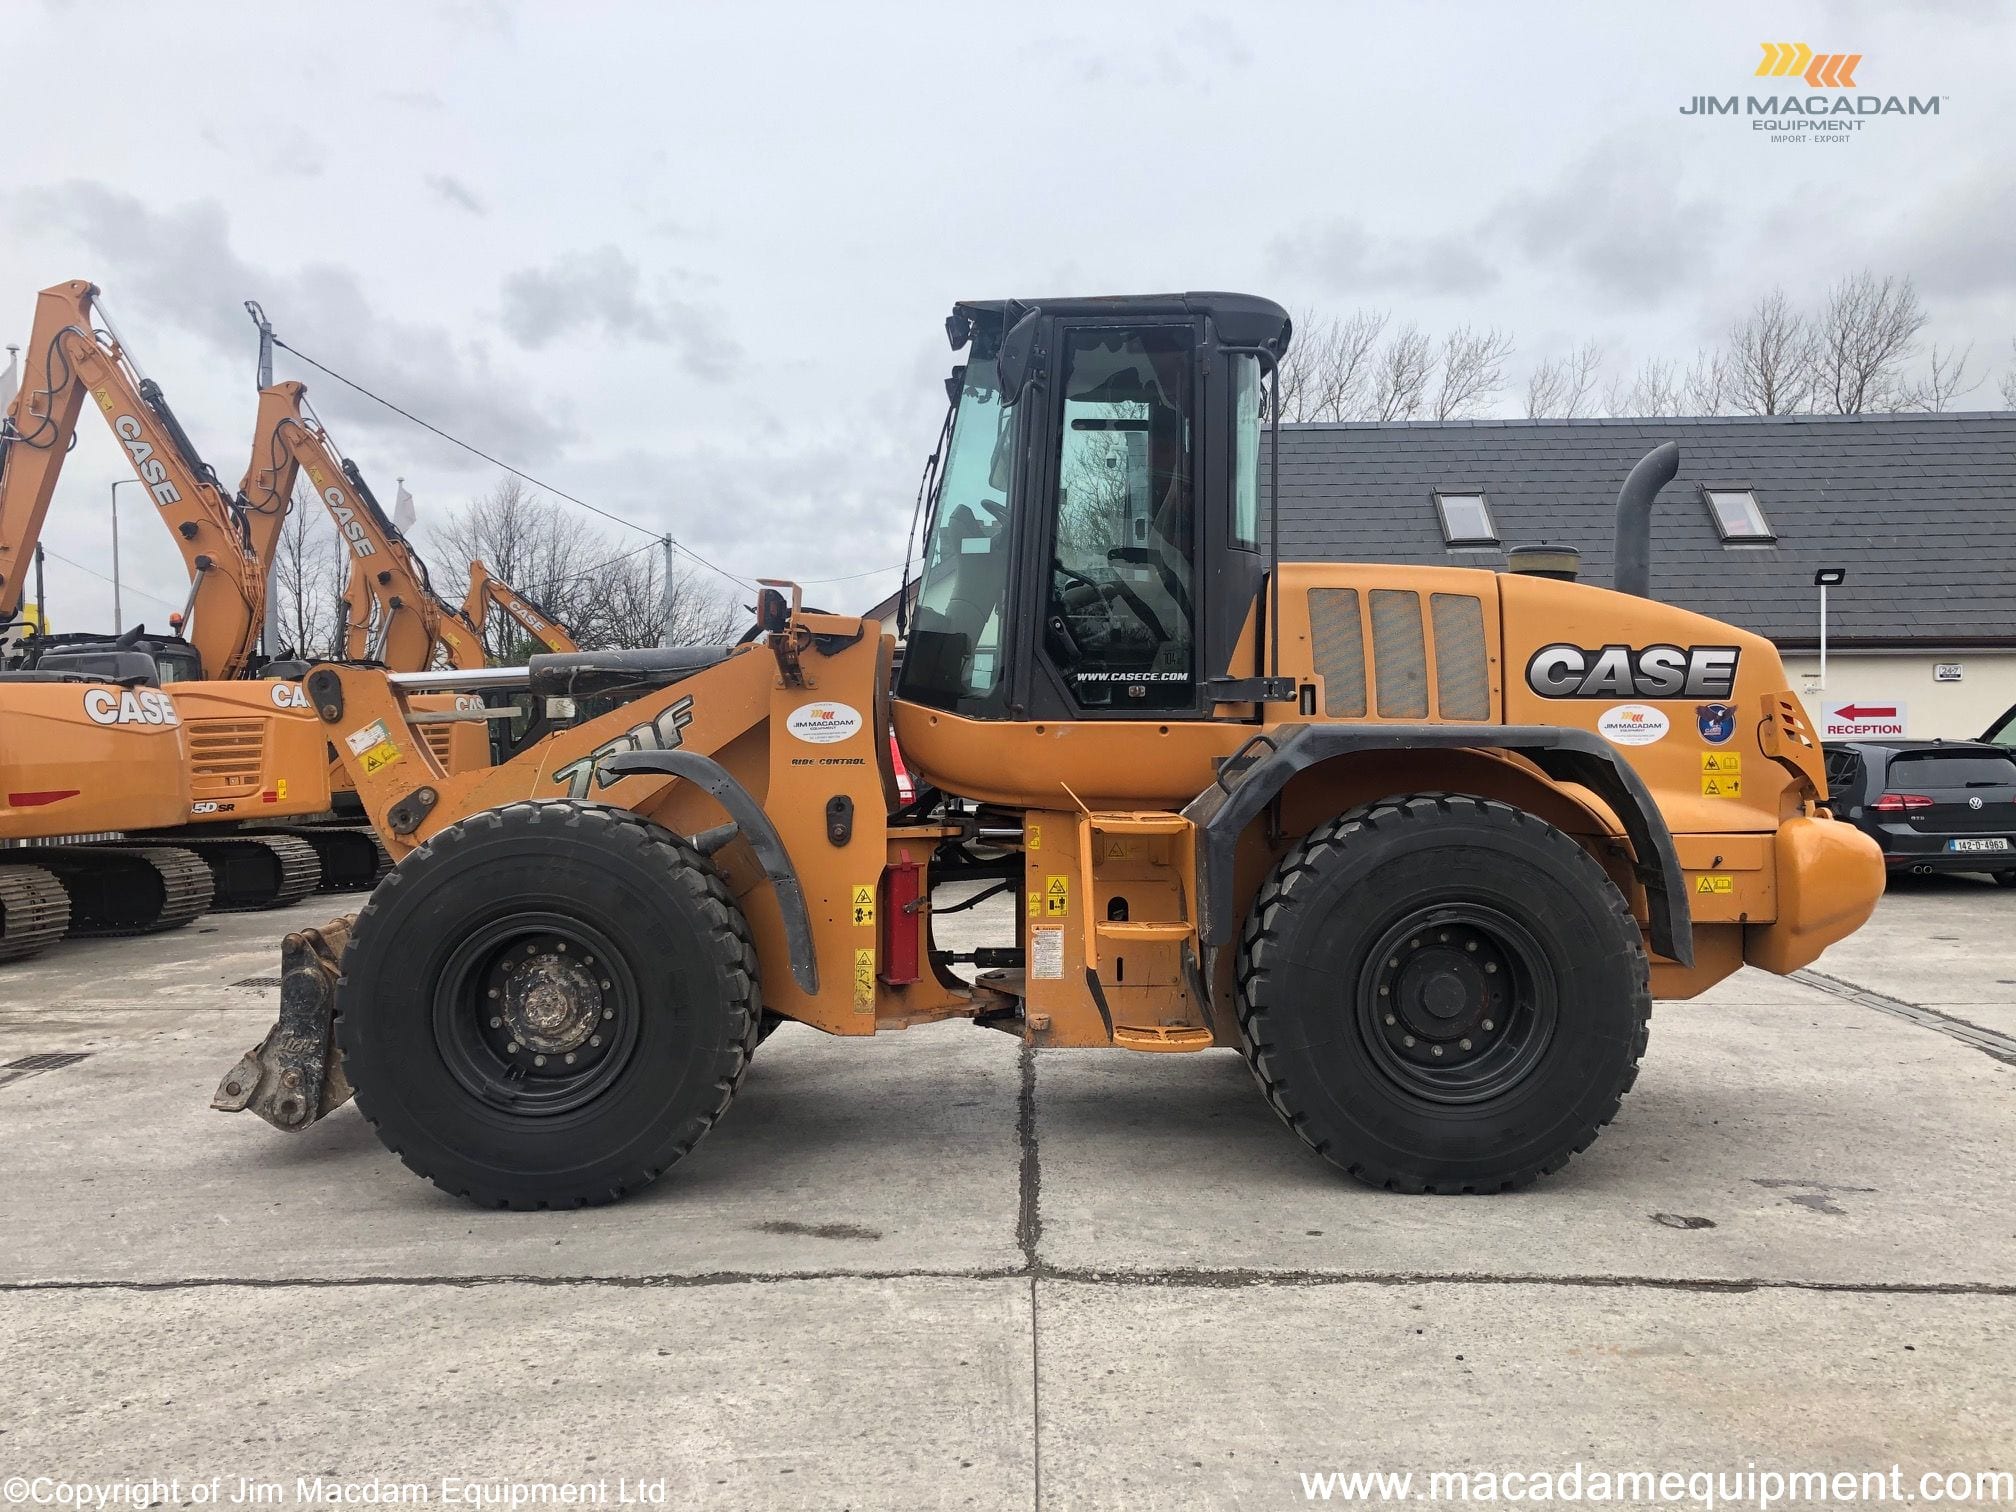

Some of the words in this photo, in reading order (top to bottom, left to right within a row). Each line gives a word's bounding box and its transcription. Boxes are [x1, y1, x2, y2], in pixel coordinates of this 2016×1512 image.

[114, 414, 183, 507] CASE
[324, 485, 377, 558] CASE
[509, 600, 546, 632] CASE
[1077, 672, 1188, 681] WWW.CASECE.COM
[1528, 647, 1738, 698] CASE
[83, 688, 178, 726] CASE
[271, 684, 312, 708] CA
[455, 697, 485, 712] CAS
[1827, 725, 1902, 735] RECEPTION
[192, 802, 218, 814] 5D
[218, 804, 235, 812] SR
[1958, 840, 2004, 850] 142-D-4963
